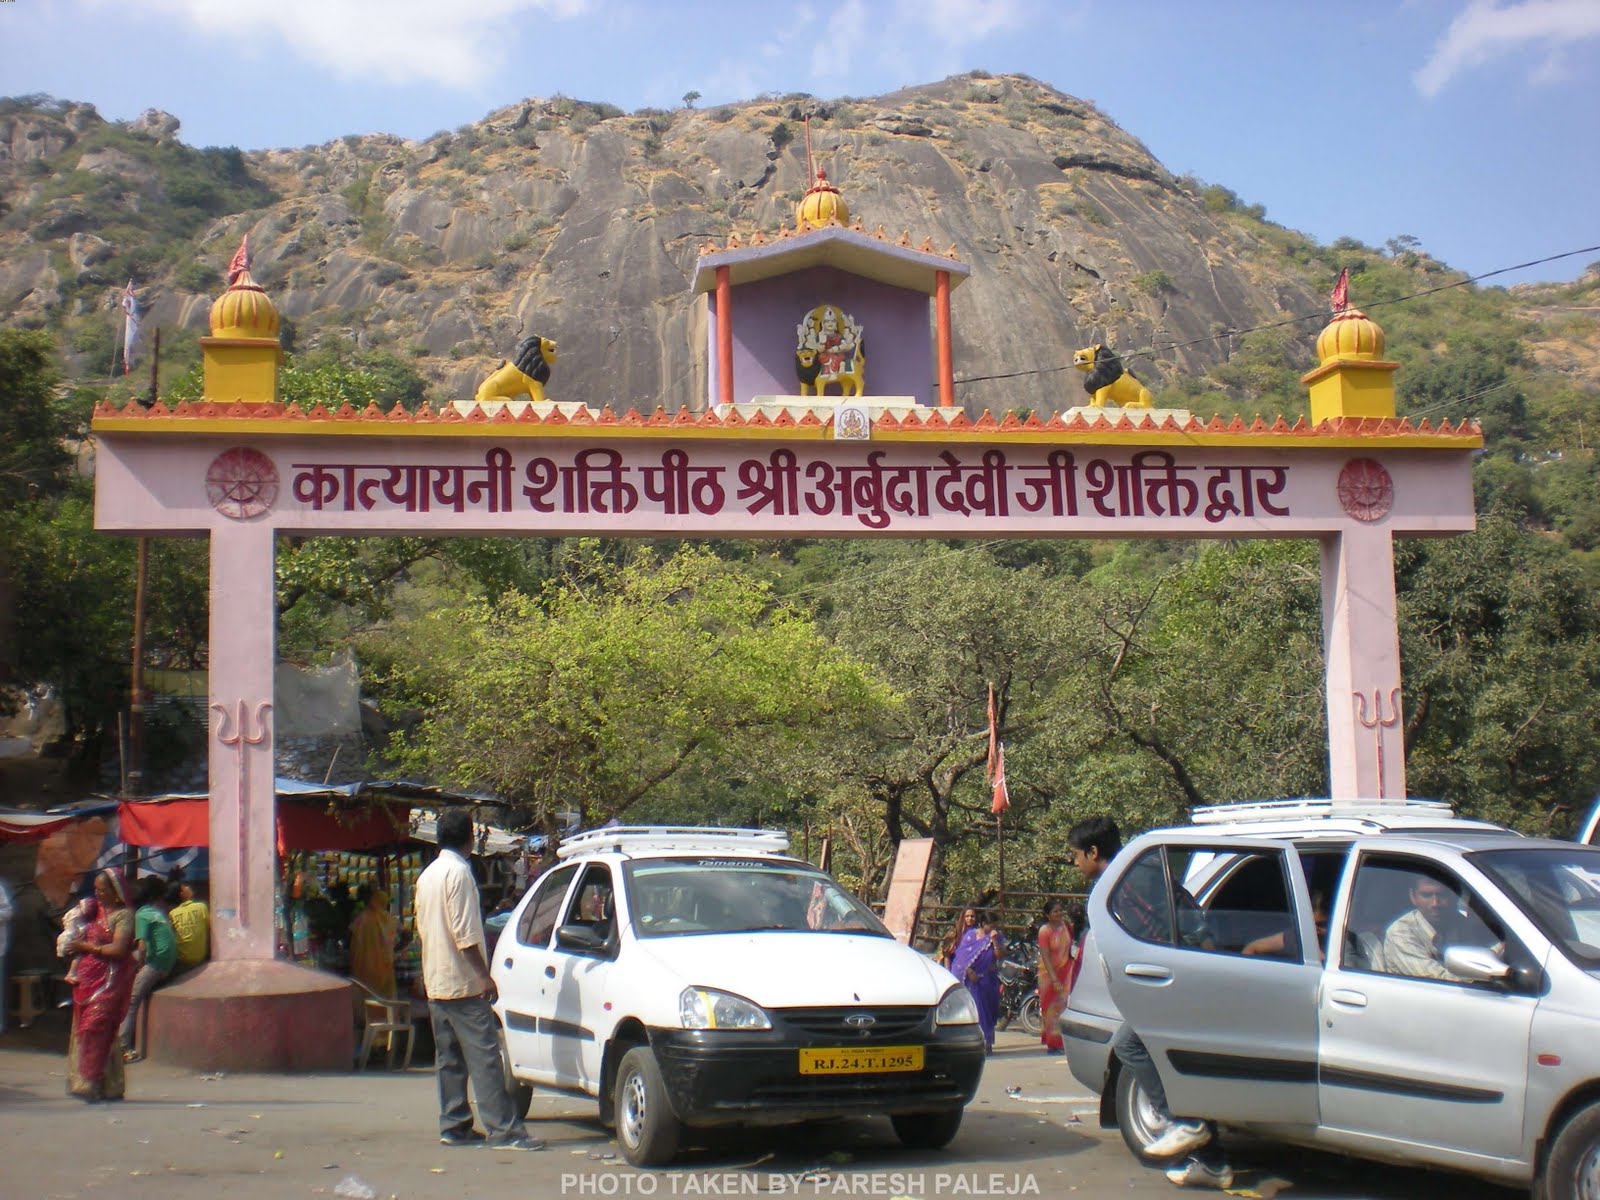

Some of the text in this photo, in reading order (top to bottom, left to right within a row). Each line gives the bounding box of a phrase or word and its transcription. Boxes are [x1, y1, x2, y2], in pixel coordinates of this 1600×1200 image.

[291, 447, 516, 513] कात्यायनी
[737, 449, 801, 516] श्री
[697, 860, 764, 868] Tamanna
